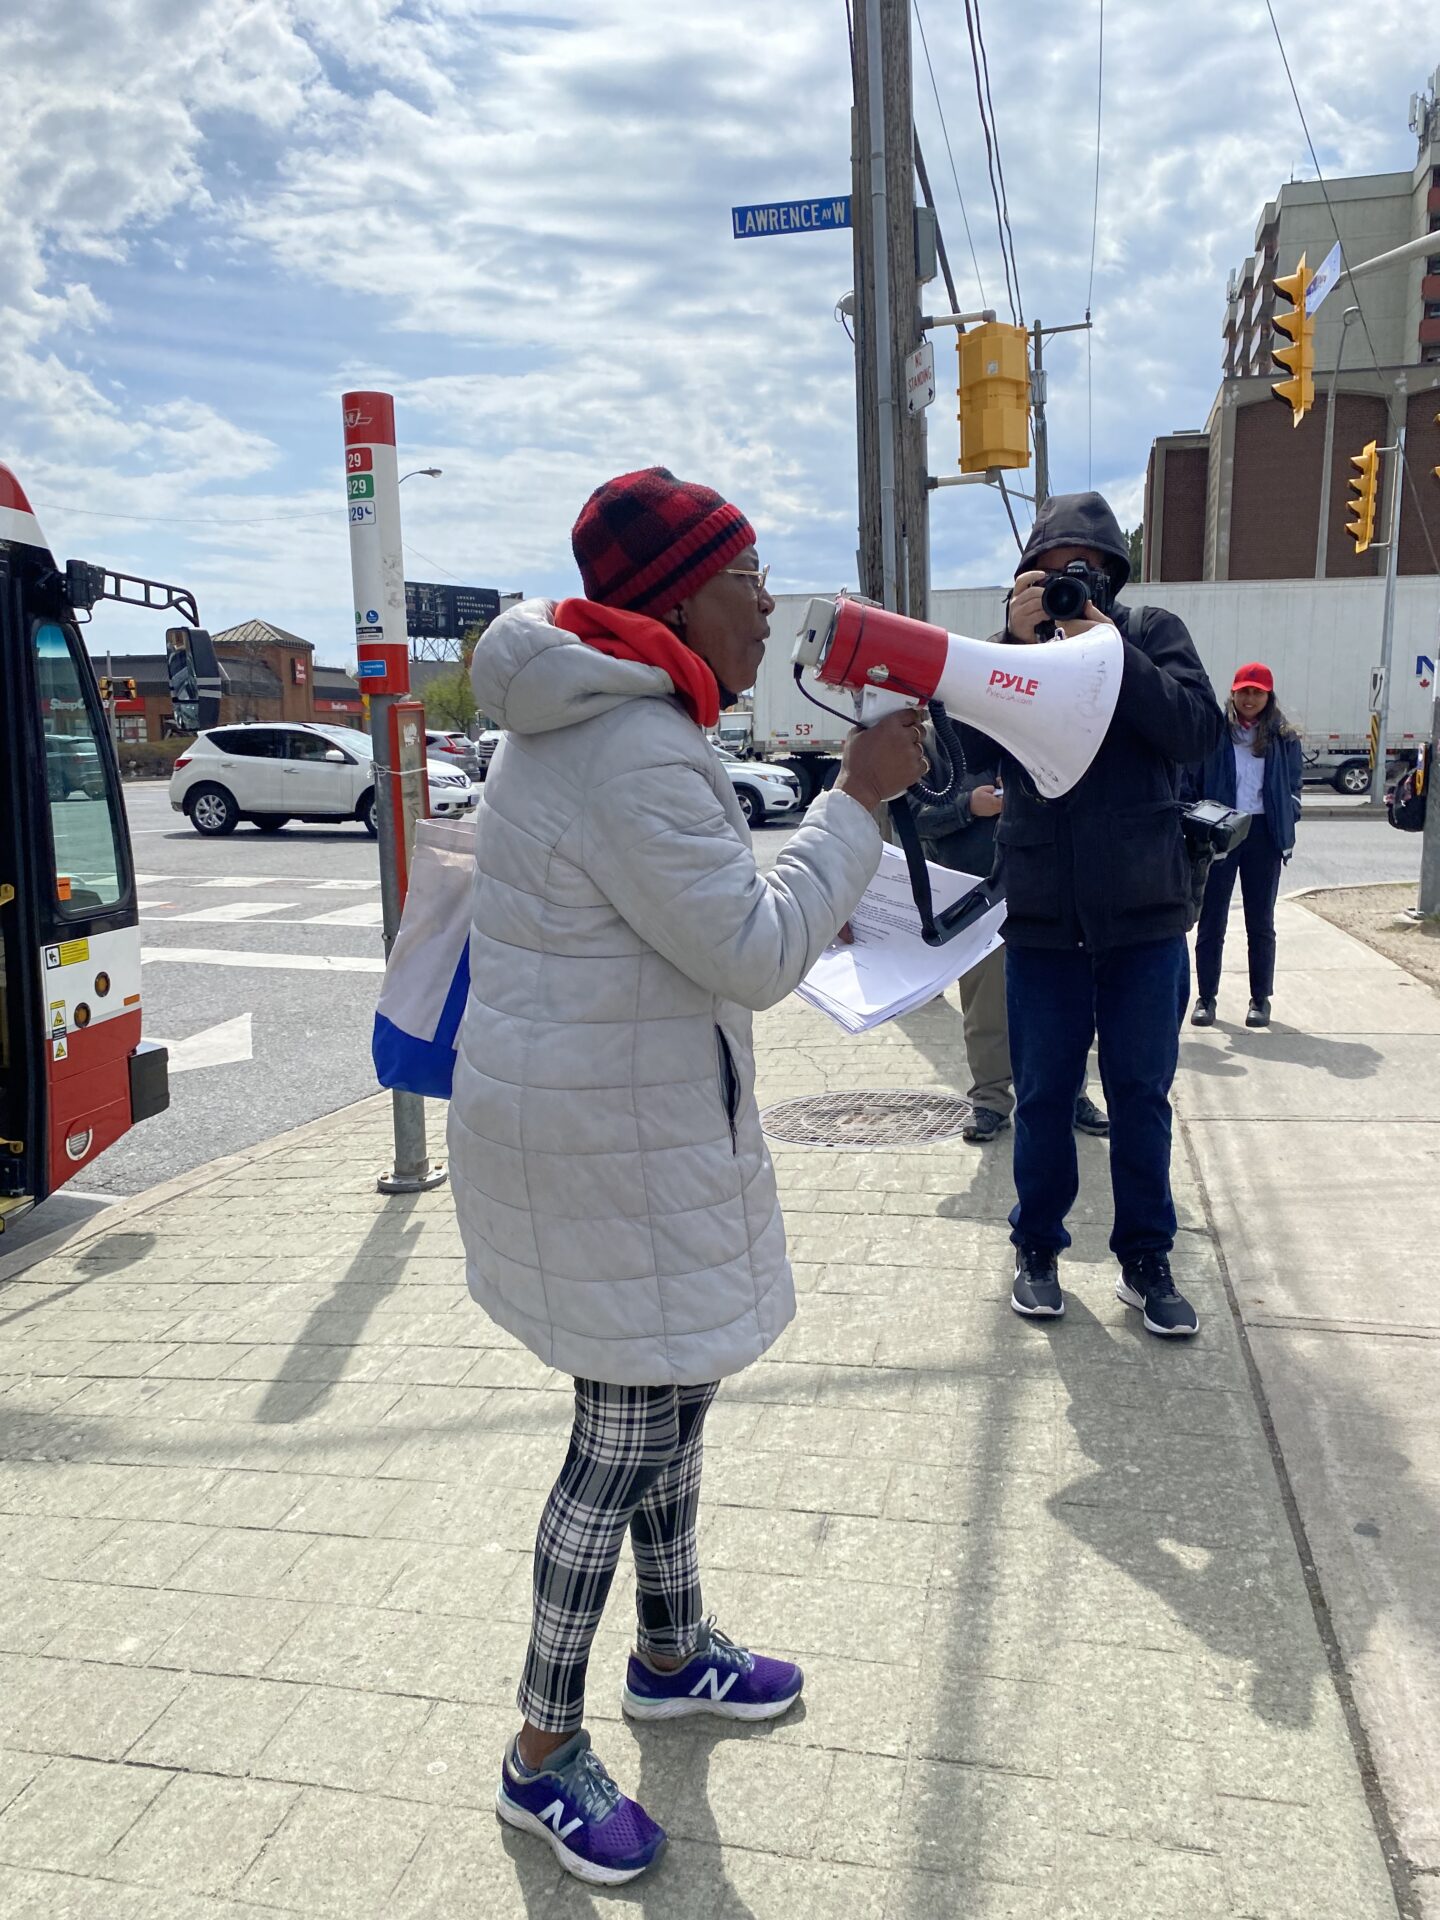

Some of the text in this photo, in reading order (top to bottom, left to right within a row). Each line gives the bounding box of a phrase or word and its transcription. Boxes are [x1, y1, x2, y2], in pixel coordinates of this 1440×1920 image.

[734, 201, 846, 234] LAWRENCE AV W
[914, 351, 922, 369] NO
[907, 366, 932, 393] STANDING
[348, 452, 362, 468] 29
[347, 479, 367, 495] 929
[348, 506, 364, 522] 29
[989, 669, 1039, 697] PYLE
[795, 724, 814, 736] 53'
[688, 1667, 739, 1701] N
[537, 1798, 584, 1841] N
